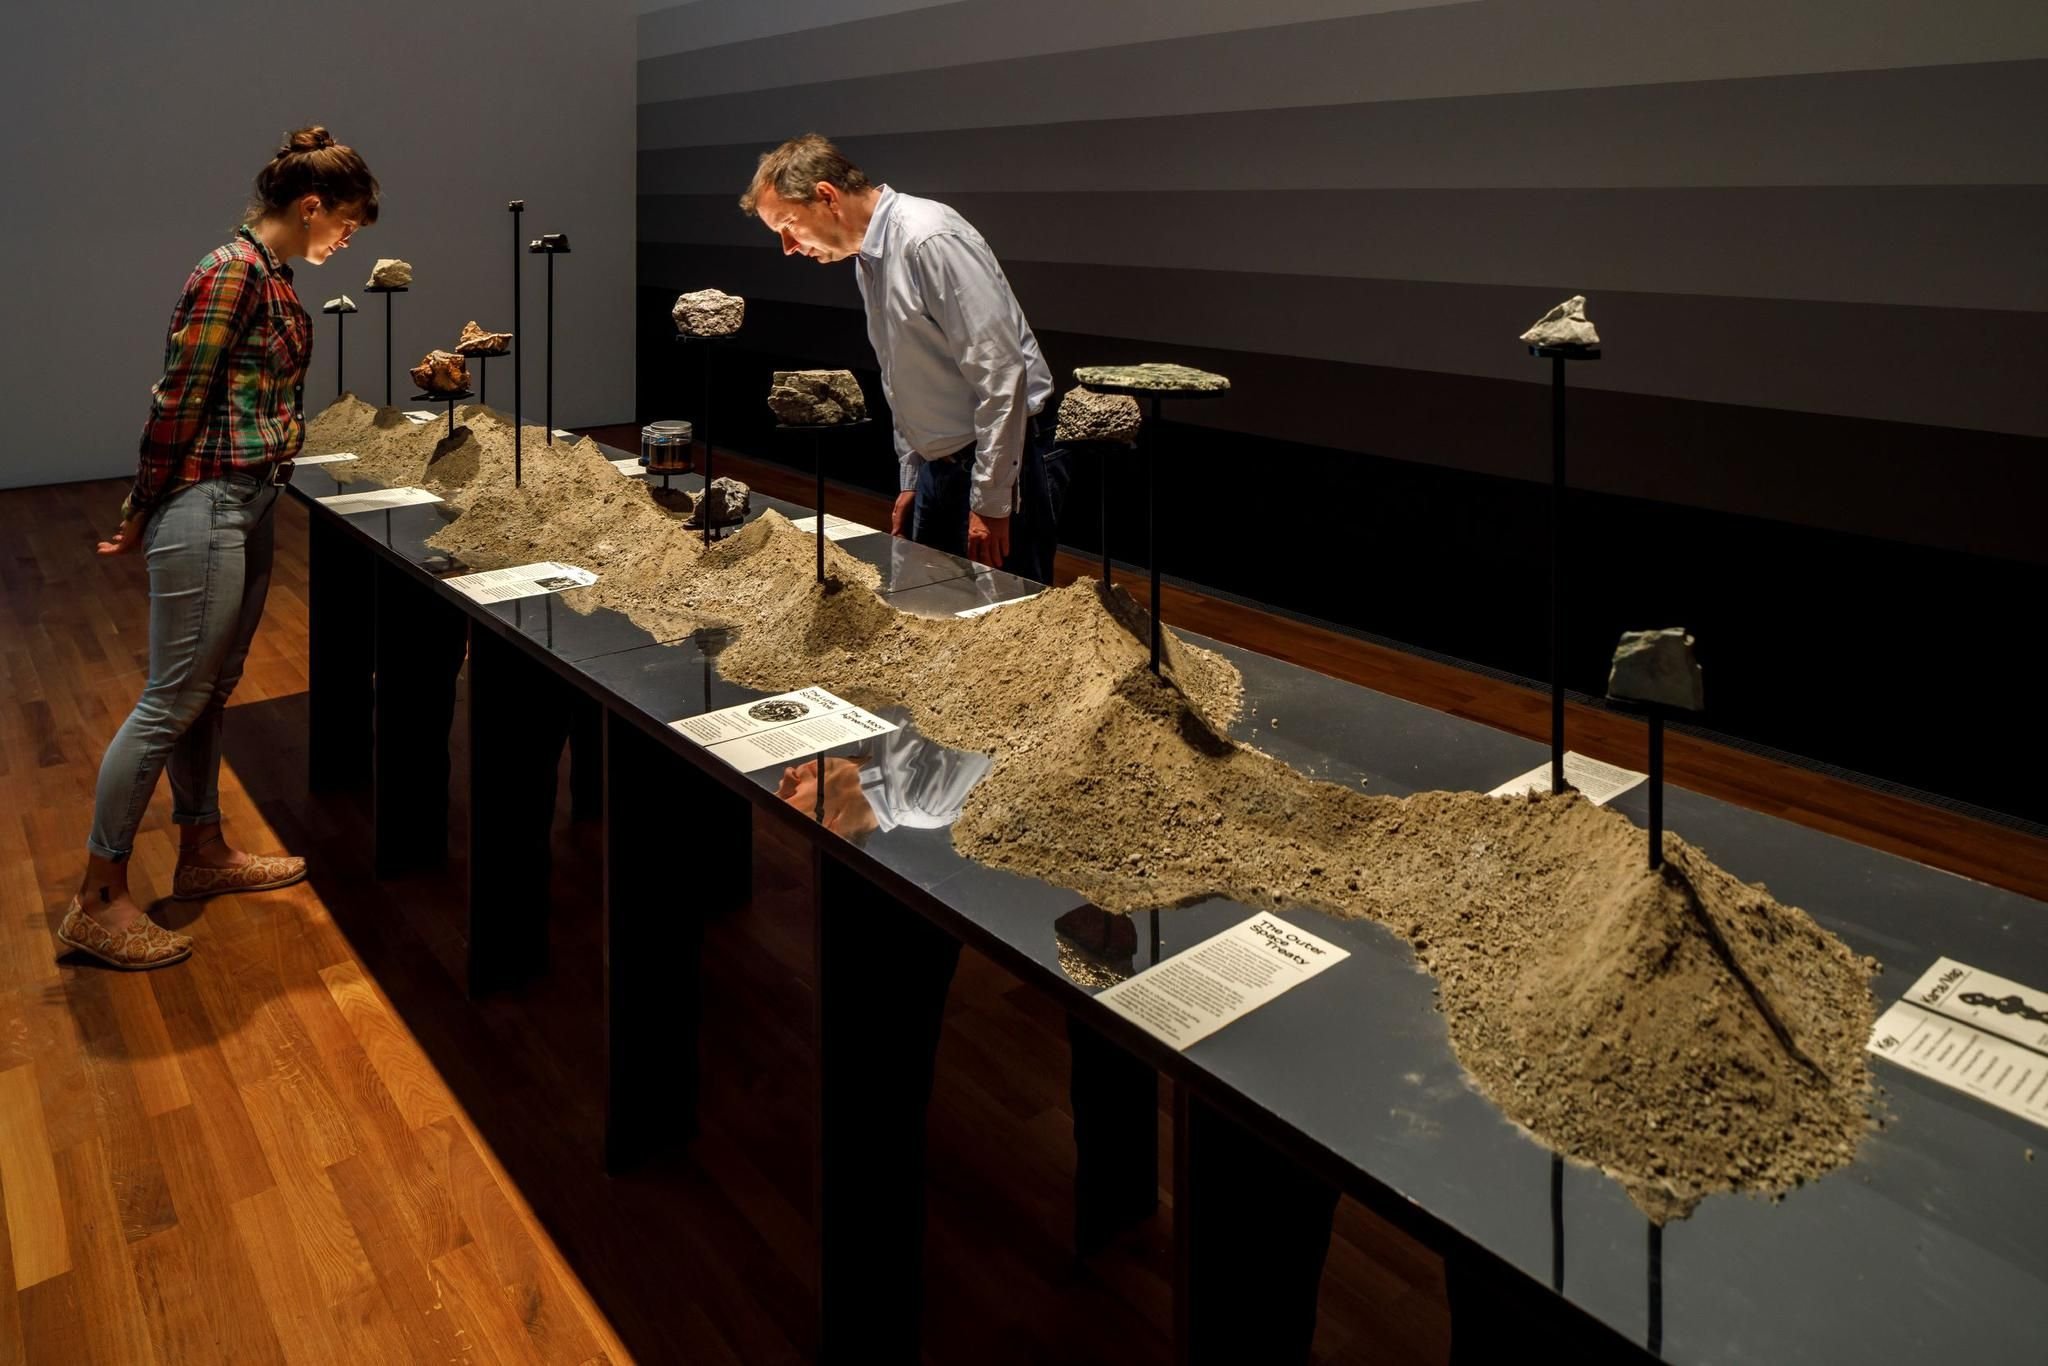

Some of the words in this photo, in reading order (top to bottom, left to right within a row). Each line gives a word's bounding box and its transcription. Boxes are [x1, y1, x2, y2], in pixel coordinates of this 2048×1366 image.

[1249, 924, 1290, 947] Space
[1260, 920, 1284, 935] The
[1286, 934, 1327, 955] Outer
[1265, 940, 1311, 965] Treaty
